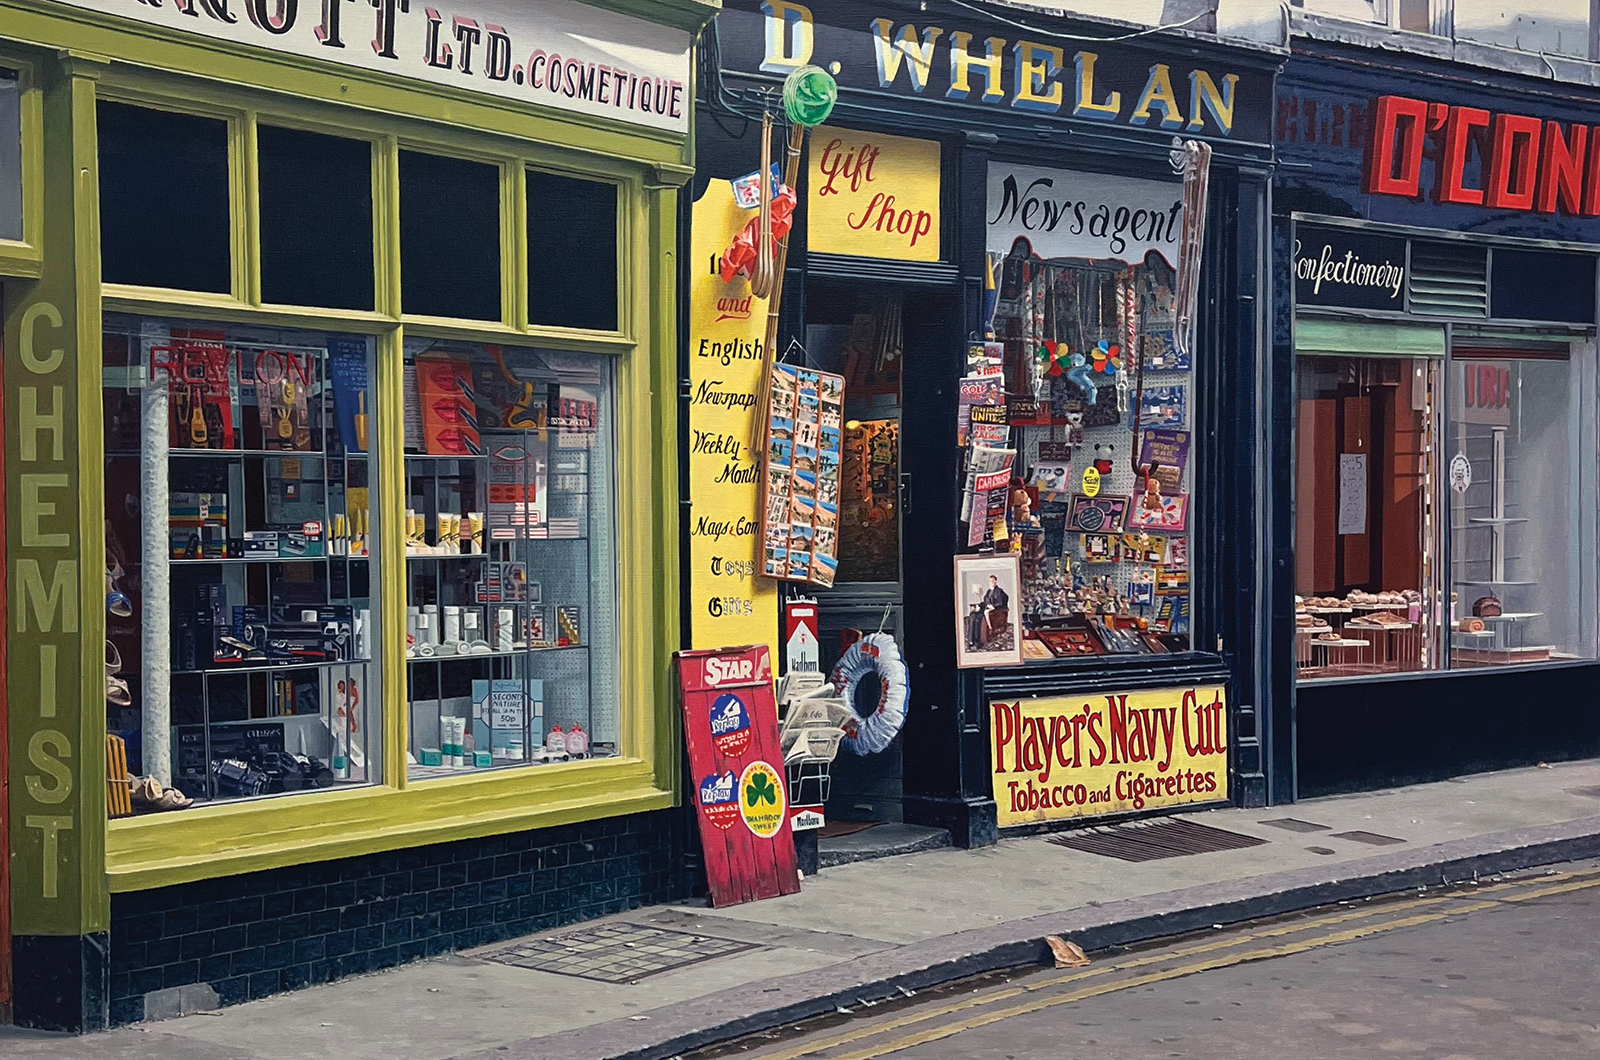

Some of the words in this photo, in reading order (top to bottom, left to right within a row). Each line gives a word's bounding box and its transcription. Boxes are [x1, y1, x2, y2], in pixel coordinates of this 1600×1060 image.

[423, 8, 523, 85] LTD.
[527, 49, 683, 118] COSMETIQUE
[759, 0, 841, 75] D.
[870, 18, 1239, 135] WHELAN
[819, 138, 880, 196] Gift
[847, 193, 931, 247] Shop
[988, 174, 1182, 254] Newsagent
[716, 296, 752, 318] and
[698, 338, 763, 366] English
[711, 556, 755, 580] Toys
[15, 301, 79, 898] CHEMIST
[704, 657, 753, 685] STAR
[492, 693, 523, 701] SECOND
[501, 715, 516, 723] 50p
[992, 700, 1107, 783] Player's
[1105, 695, 1178, 772] Navy
[1182, 689, 1227, 757] Cut
[1008, 779, 1087, 813] Tobacco
[1089, 785, 1111, 804] and
[1115, 769, 1217, 810] Cigarettes
